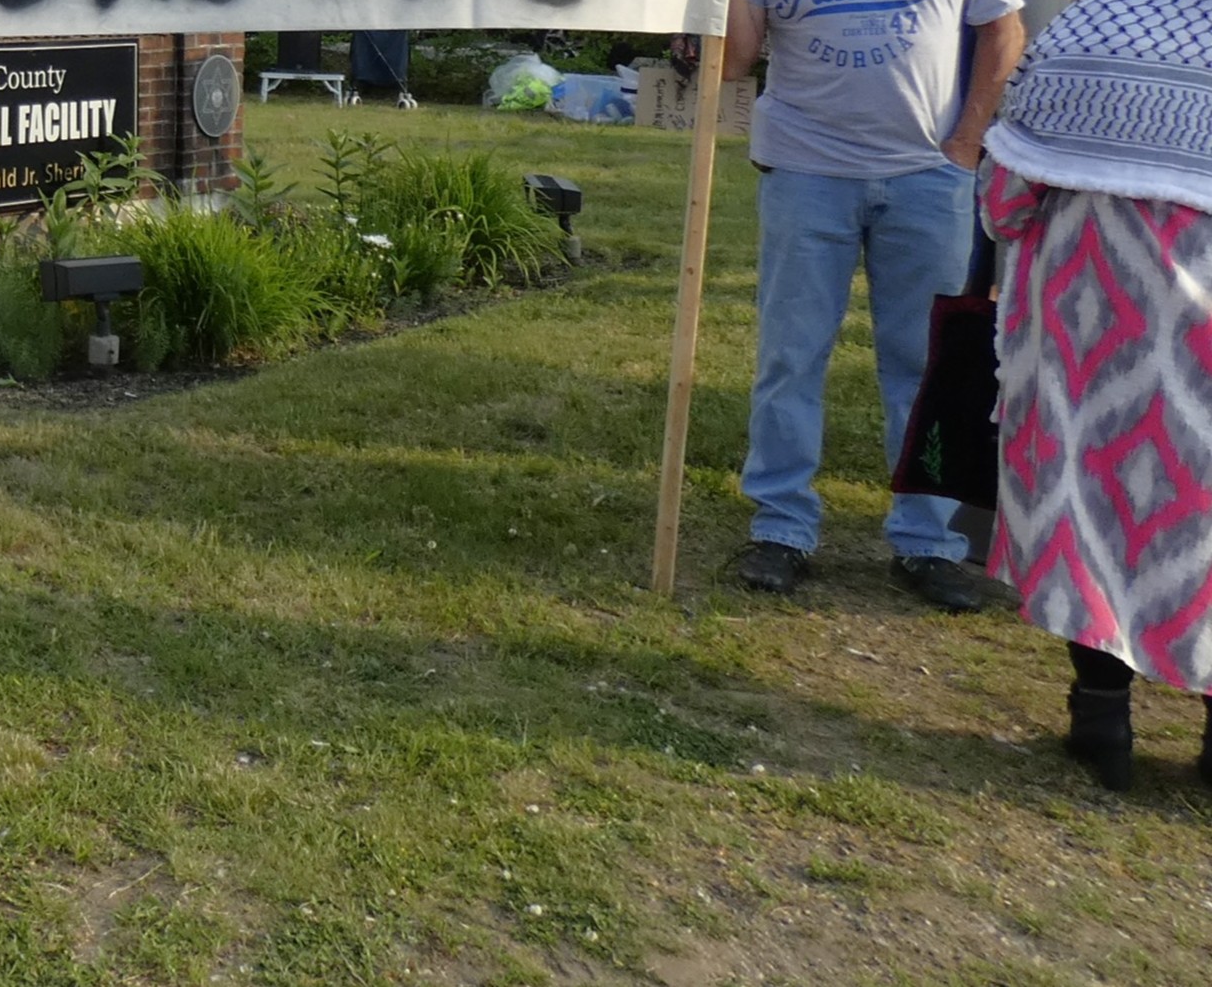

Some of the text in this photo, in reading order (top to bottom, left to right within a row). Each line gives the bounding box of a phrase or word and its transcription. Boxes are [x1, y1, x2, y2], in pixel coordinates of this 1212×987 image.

[808, 36, 914, 69] GEORGIA
[18, 98, 117, 144] FACILITY
[21, 167, 39, 187] Jr.
